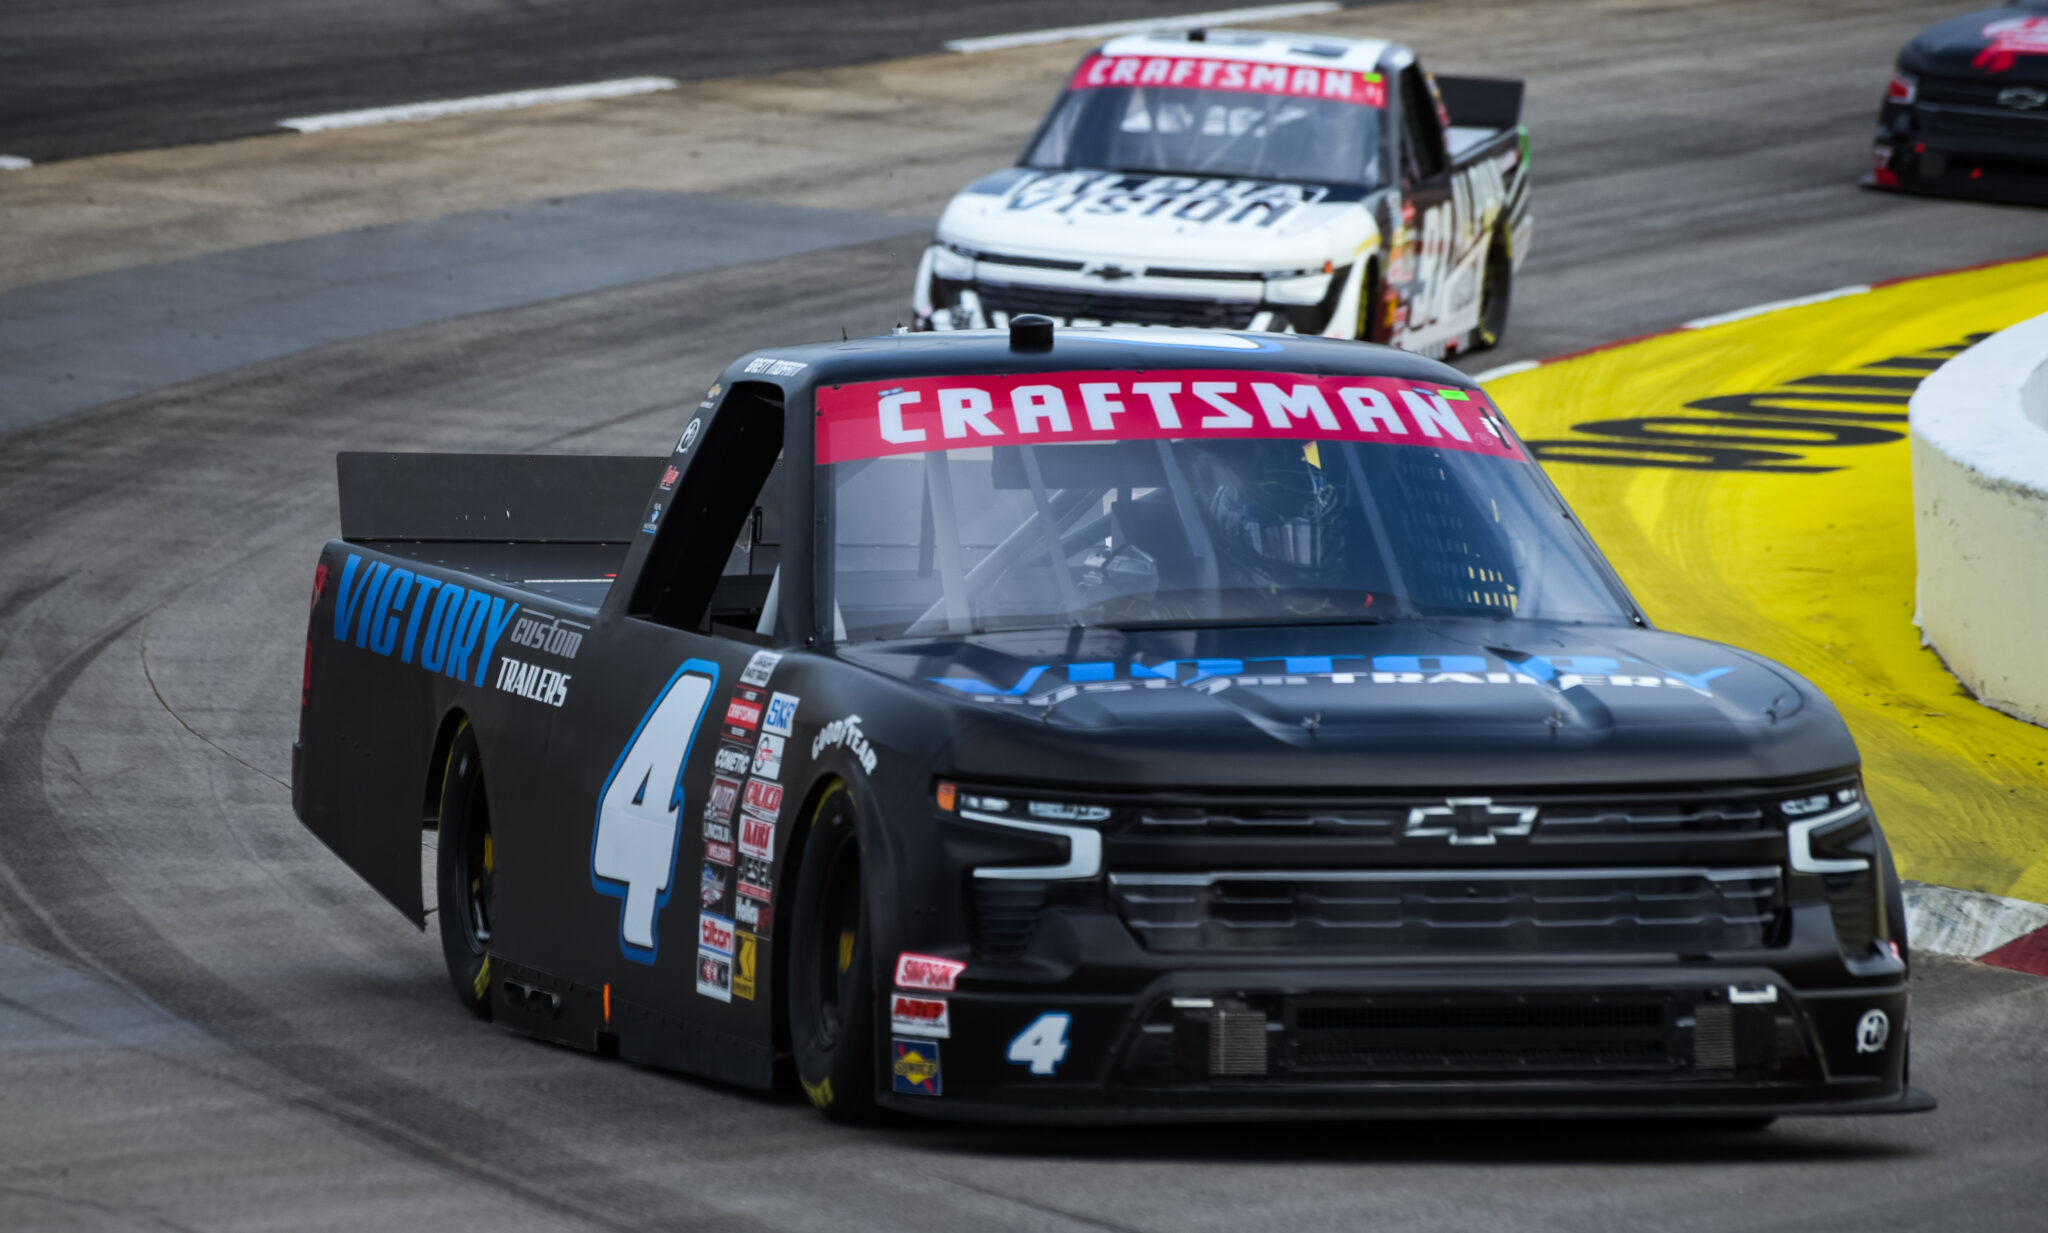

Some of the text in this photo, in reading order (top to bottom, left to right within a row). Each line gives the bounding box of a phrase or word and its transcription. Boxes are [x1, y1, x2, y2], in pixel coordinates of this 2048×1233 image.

[1088, 57, 1351, 98] CRAFTSMAN
[1005, 188, 1296, 227] VISION
[878, 381, 1473, 444] CRAFTSMAN
[333, 554, 520, 688] VICTORY
[496, 656, 572, 709] TRAILERS
[590, 658, 720, 966] 4
[1005, 1010, 1071, 1077] 4
